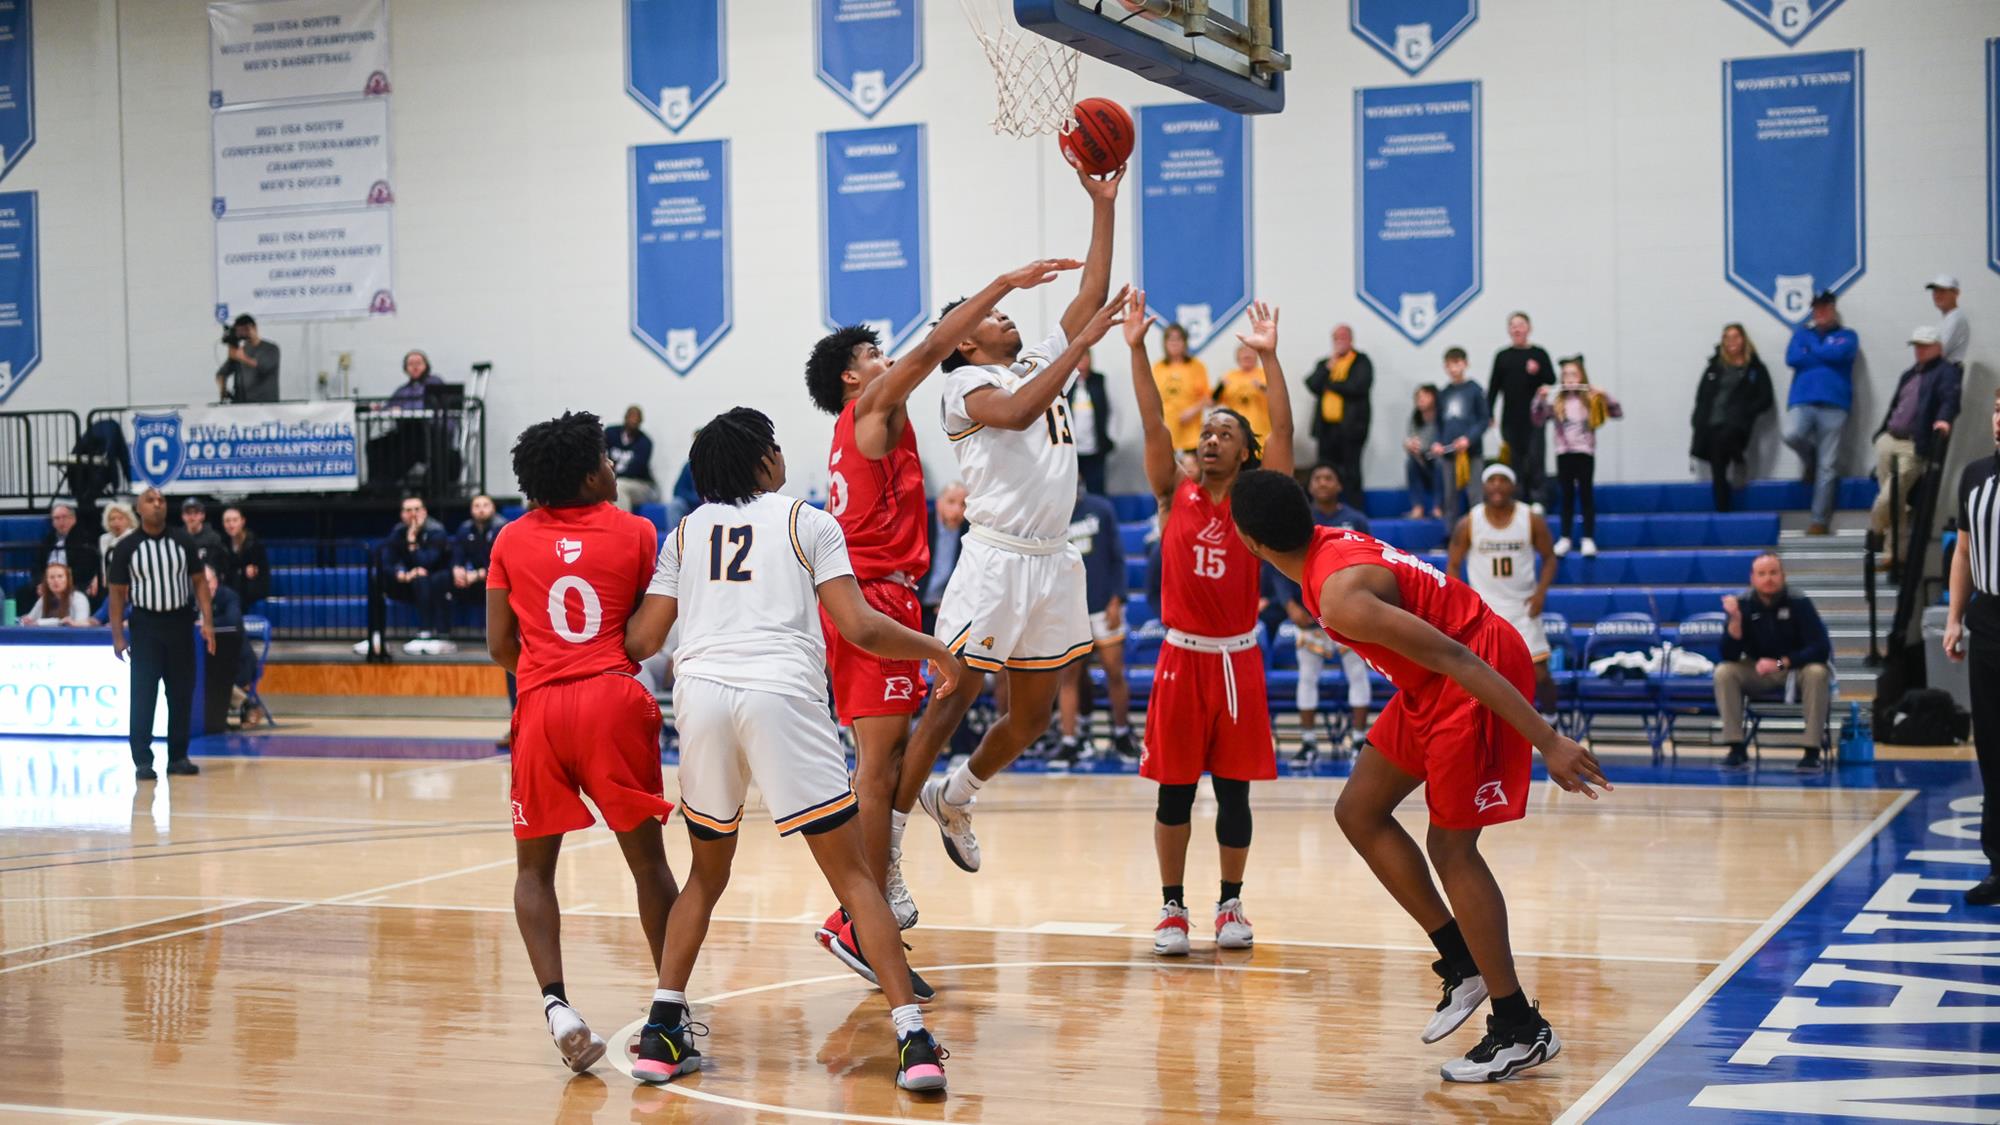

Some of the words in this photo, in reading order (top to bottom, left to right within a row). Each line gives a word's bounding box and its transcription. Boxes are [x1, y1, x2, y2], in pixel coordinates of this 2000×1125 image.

[302, 15, 341, 29] SOUTH
[1783, 7, 1799, 27] C
[307, 30, 375, 47] CHAMPIONS
[1407, 38, 1421, 59] C
[281, 52, 352, 67] BASKETBALL
[1735, 76, 1798, 90] WOMEN'S
[1801, 72, 1850, 86] TENNIS
[305, 120, 344, 132] SOUTH
[222, 143, 294, 158] CONFERENCE
[299, 135, 381, 150] TOURNAMENT
[266, 157, 334, 173] CHAMPIONS
[308, 228, 345, 241] SOUTH
[225, 249, 296, 265] CONFERENCE
[301, 244, 384, 259] TOURNAMENT
[269, 265, 336, 280] CHAMPIONS
[1787, 291, 1802, 311] C
[1411, 308, 1425, 329] C
[140, 423, 176, 439] SCOTS
[1046, 404, 1073, 446] 13
[145, 437, 168, 475] C
[184, 461, 352, 478] ATHLETICS.COVENANT.EDU
[709, 524, 754, 582] 12
[1193, 545, 1227, 579] 15
[1492, 556, 1512, 577] 10
[547, 576, 603, 643] 0
